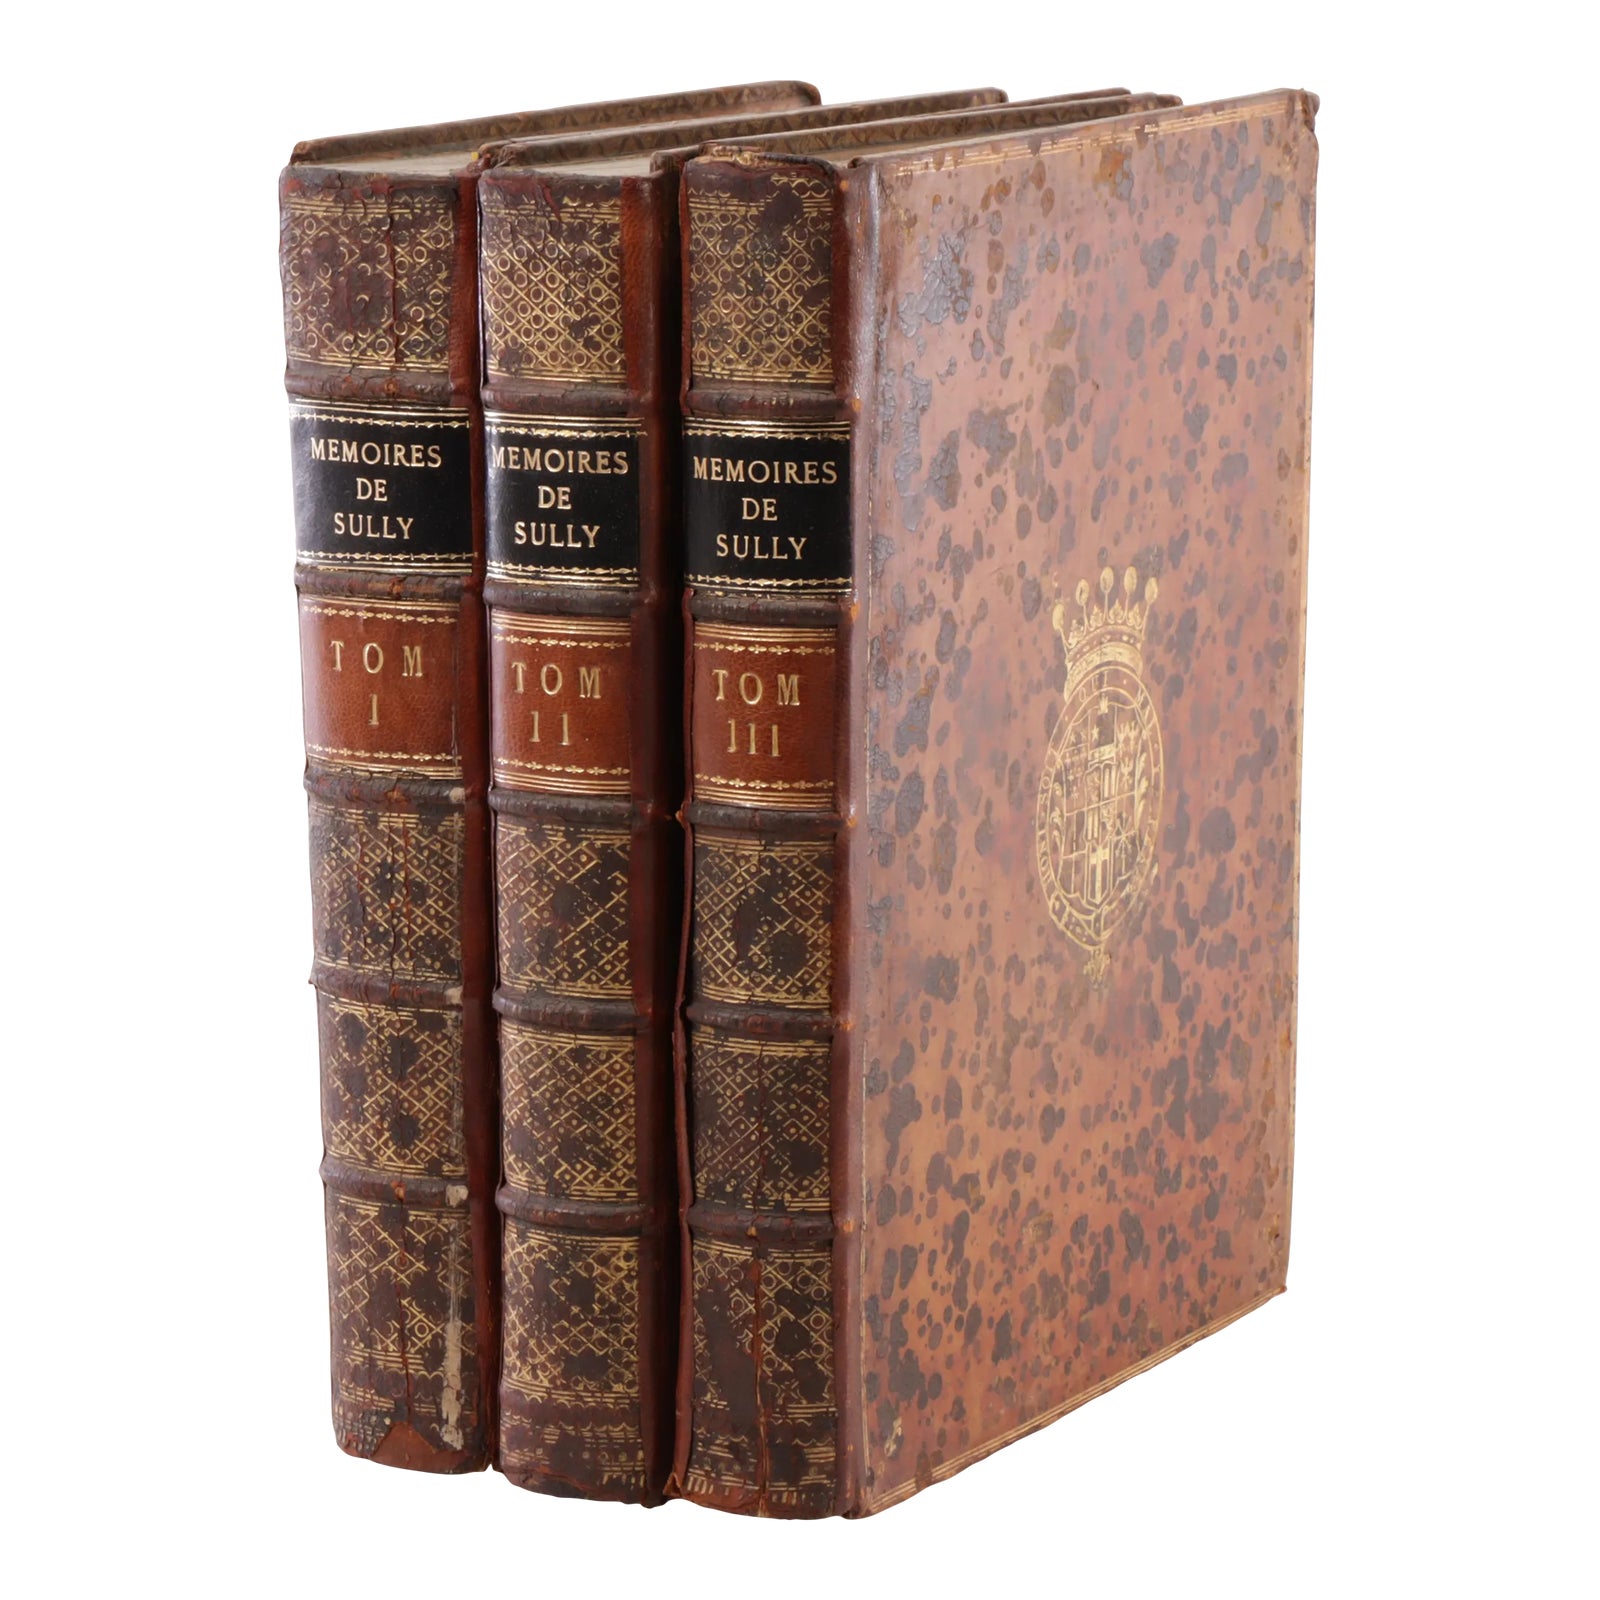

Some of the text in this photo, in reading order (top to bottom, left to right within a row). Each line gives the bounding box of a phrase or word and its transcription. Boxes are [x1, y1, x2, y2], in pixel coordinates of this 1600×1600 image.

[309, 438, 442, 469] MEMOIRES
[491, 445, 629, 476] MEMOIRES
[692, 456, 838, 485] MEMOIRES
[355, 478, 388, 502] DE
[537, 484, 572, 511] DE
[741, 497, 778, 522] DE
[333, 511, 414, 540] SULLY
[514, 520, 601, 549] SULLY
[716, 533, 808, 560] SULLY
[329, 639, 423, 678] TOM
[511, 661, 602, 699] TOM
[711, 668, 801, 707] TOM
